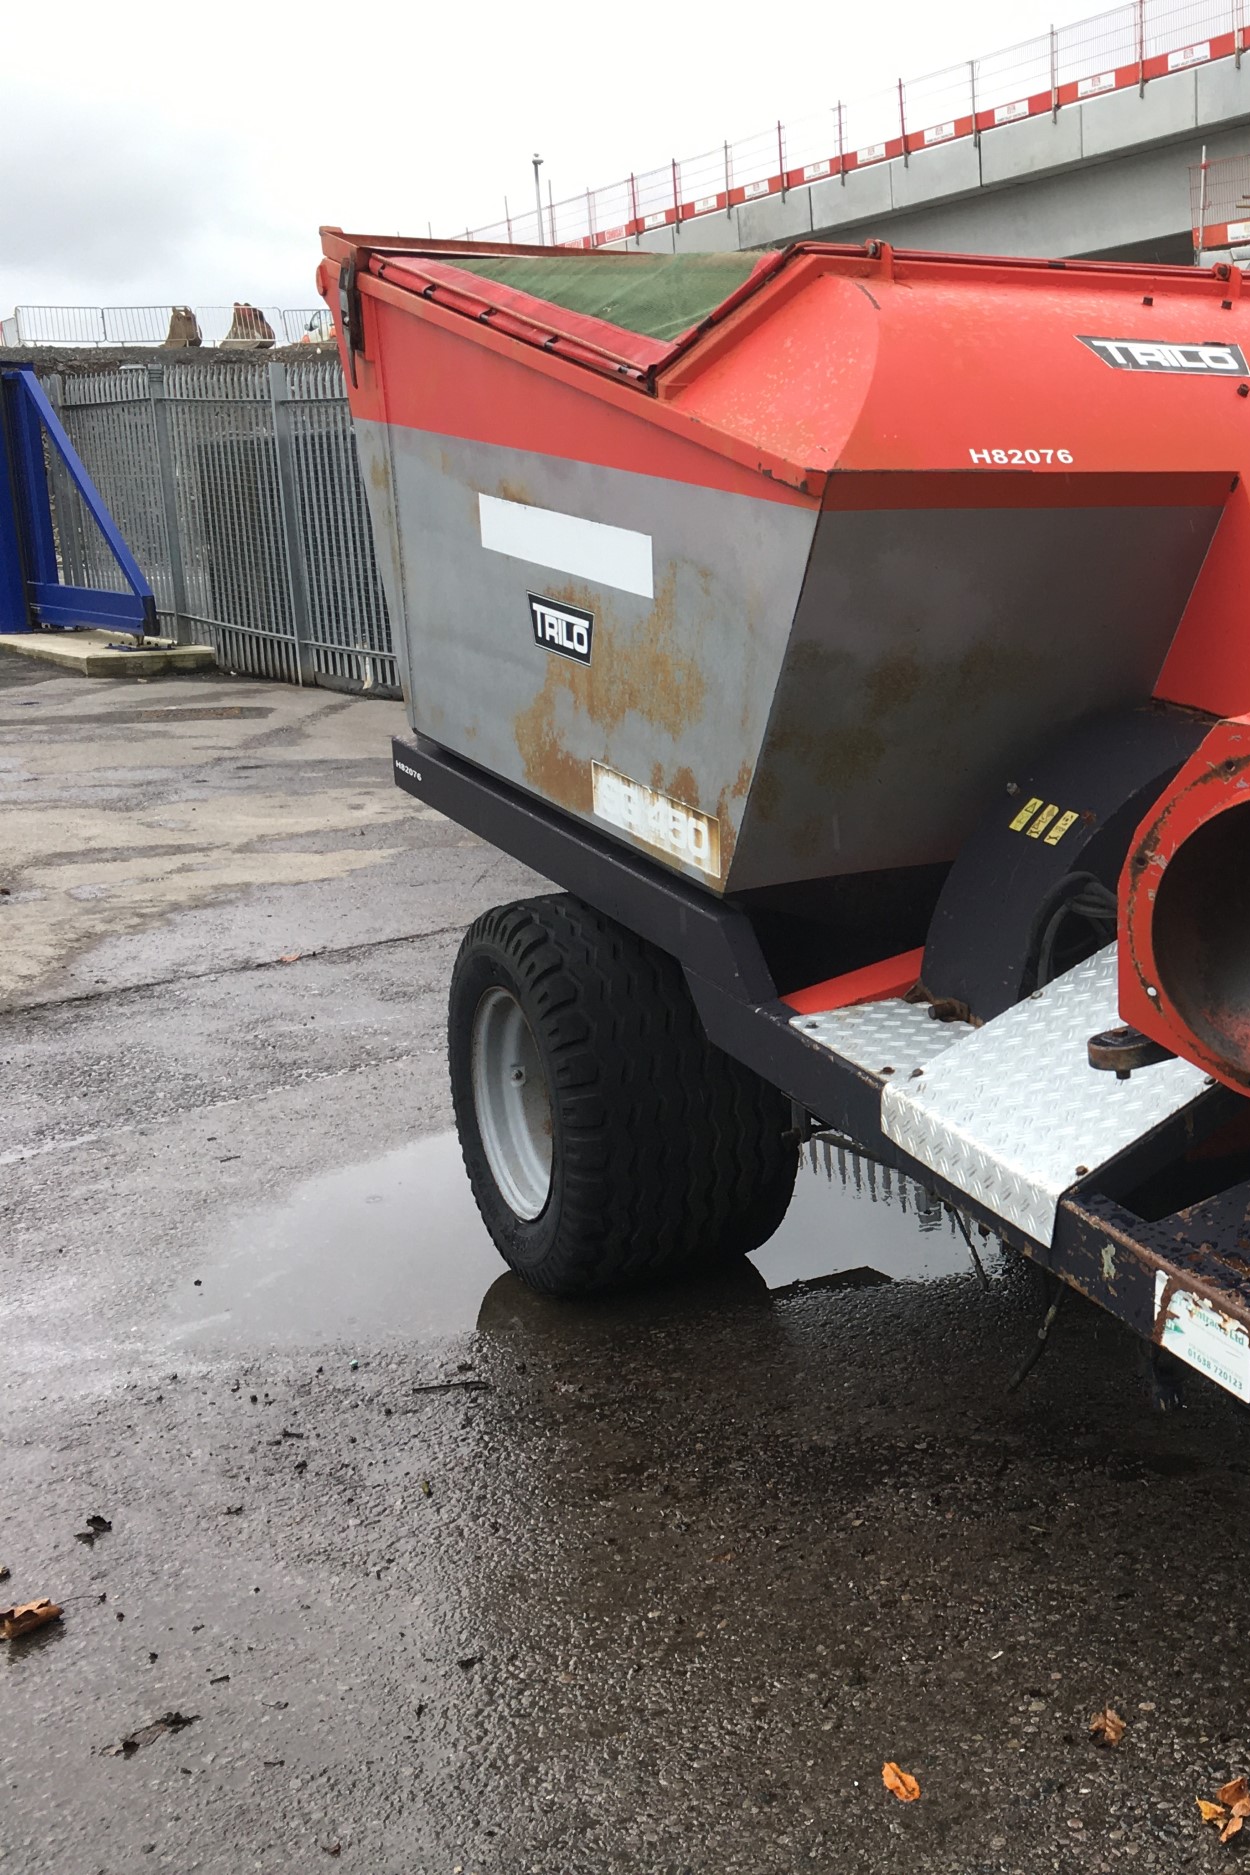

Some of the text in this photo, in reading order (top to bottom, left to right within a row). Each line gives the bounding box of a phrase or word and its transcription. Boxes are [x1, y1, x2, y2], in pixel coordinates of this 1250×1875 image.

[1091, 340, 1240, 370] TRILO
[969, 448, 1074, 464] H82076
[532, 602, 590, 655] TRILO
[395, 760, 422, 781] H82076
[1229, 1328, 1245, 1346] Ltd
[1187, 1347, 1212, 1370] 01638
[1213, 1364, 1243, 1390] 720123
